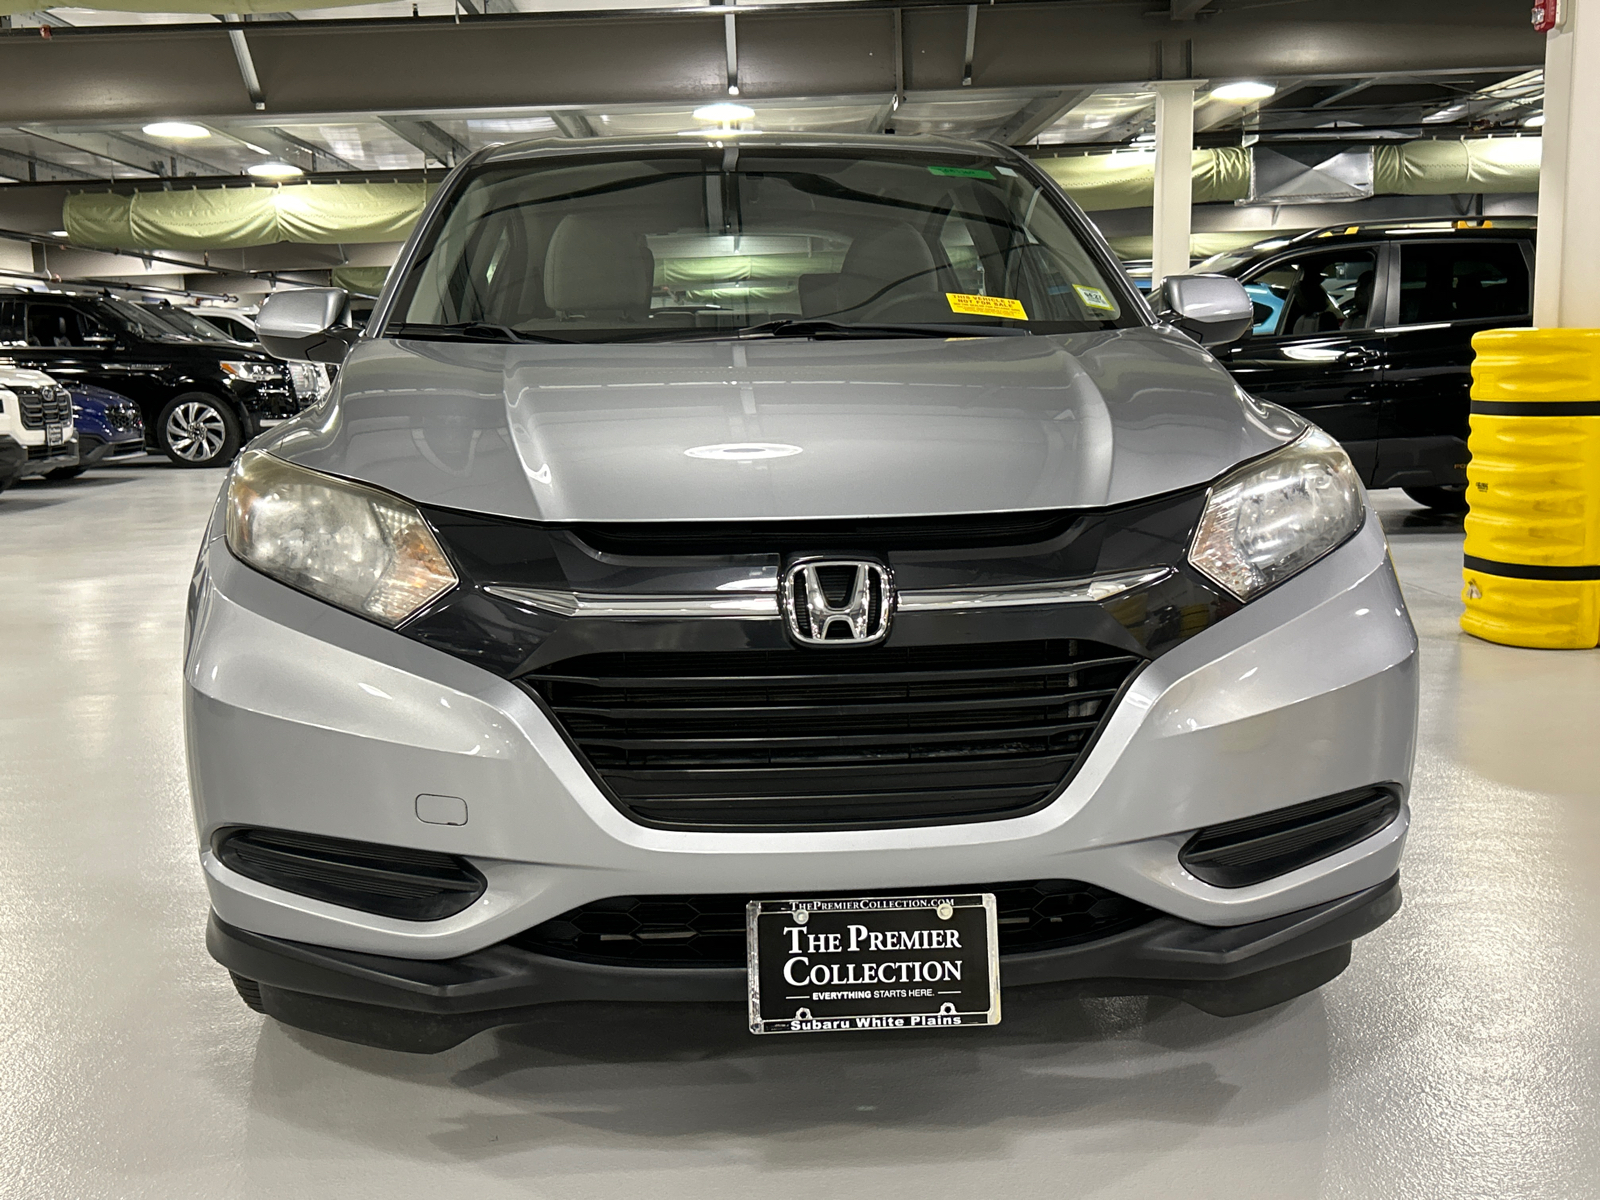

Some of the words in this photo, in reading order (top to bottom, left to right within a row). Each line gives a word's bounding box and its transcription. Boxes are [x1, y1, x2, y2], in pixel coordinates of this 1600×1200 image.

[783, 926, 842, 954] THE
[847, 924, 962, 952] PREMIER
[783, 956, 962, 986] COLLECTION
[812, 990, 872, 1000] EVERYTHING
[873, 989, 907, 998] STARTS
[908, 988, 935, 997] HERE.
[790, 1019, 850, 1031] Subaru
[856, 1016, 905, 1028] White
[911, 1015, 962, 1027] Plains
